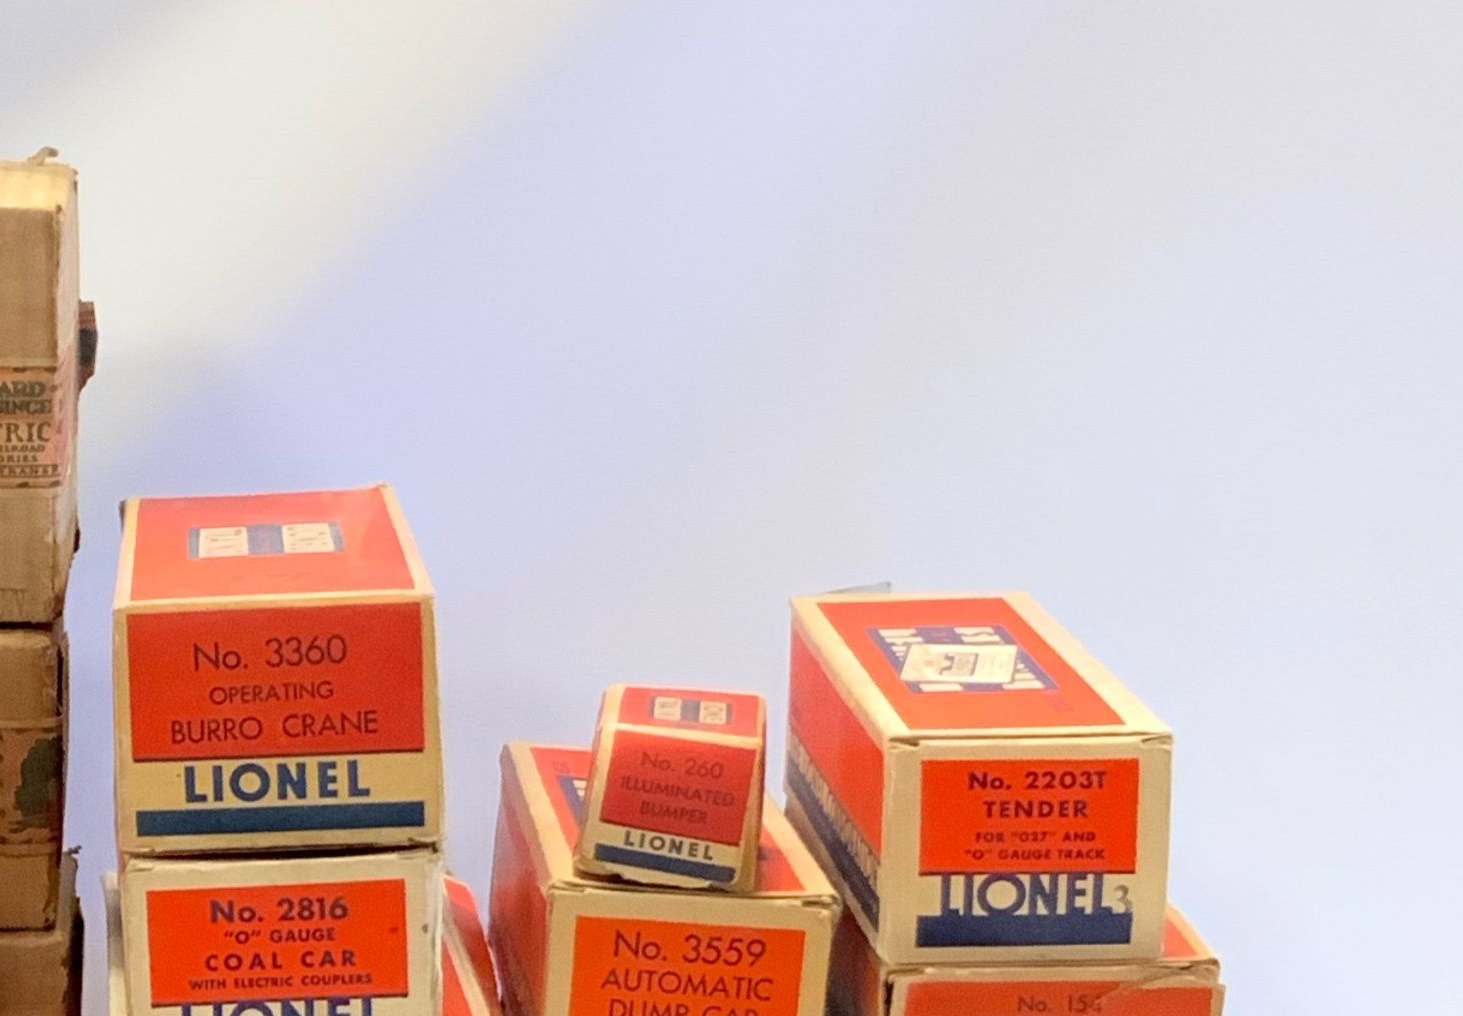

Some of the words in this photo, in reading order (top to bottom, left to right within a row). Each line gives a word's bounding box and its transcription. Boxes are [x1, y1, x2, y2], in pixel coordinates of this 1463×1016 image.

[193, 642, 248, 671] No.
[265, 634, 347, 669] 3360
[209, 680, 334, 705] OPERATING
[171, 717, 263, 745] BURRO
[282, 710, 379, 738] CRANE
[640, 751, 675, 773] No.
[685, 759, 725, 780] 260
[185, 759, 371, 803] LIONEL
[621, 775, 736, 808] ILLUMINATED
[968, 771, 1011, 790] No.
[1024, 771, 1107, 790] 2203T
[640, 801, 708, 824] BUMPER
[983, 800, 1088, 818] TENDER
[623, 830, 714, 861] LIONEL
[975, 831, 1004, 843] FOR
[1062, 831, 1096, 843] AND
[998, 848, 1052, 860] GAUGE
[1057, 848, 1106, 860] TRACK
[941, 873, 1112, 916] LIONEL
[210, 901, 263, 923] No.
[277, 897, 349, 922] 2816
[269, 927, 336, 943] GAUGE
[613, 929, 667, 961] No.
[682, 933, 767, 966] 3559
[205, 953, 283, 972] COAL
[300, 951, 357, 968] CAR
[189, 978, 227, 991] WITH
[234, 975, 294, 989] ELECTRIC
[301, 973, 373, 986] COUPLERS
[601, 968, 774, 1001] AUTOMATIC
